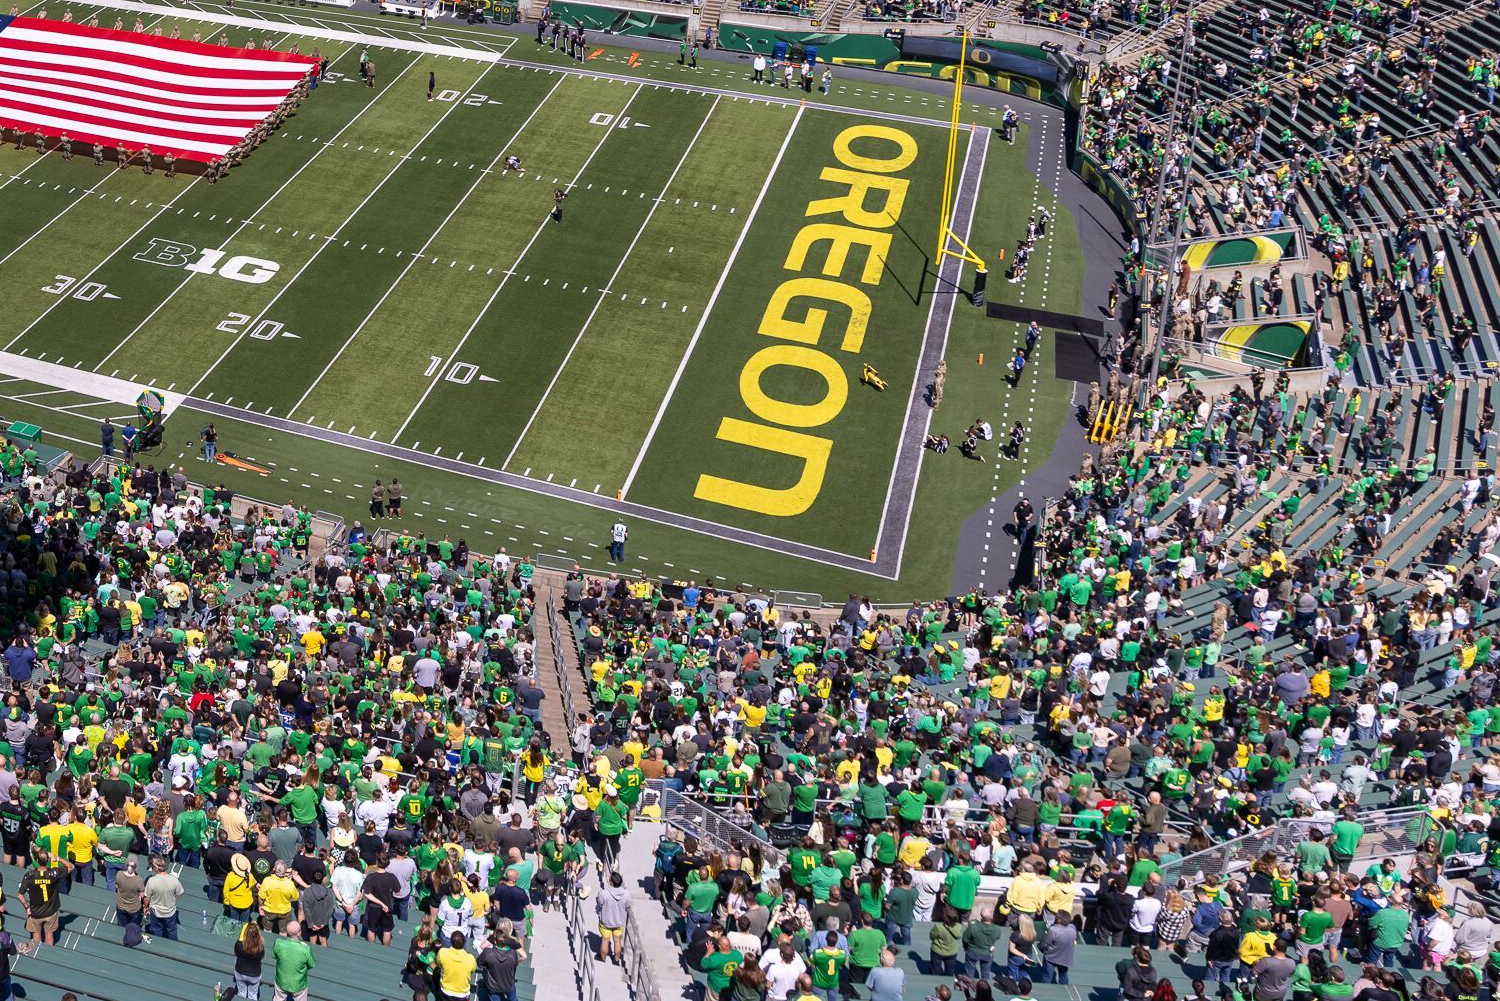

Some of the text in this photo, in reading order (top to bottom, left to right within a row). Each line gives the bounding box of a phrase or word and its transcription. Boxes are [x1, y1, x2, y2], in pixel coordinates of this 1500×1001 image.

[436, 89, 488, 107] 20
[589, 112, 632, 129] 10
[41, 275, 107, 302] 30
[216, 311, 285, 340] 20
[693, 124, 919, 517] OREGON
[423, 355, 481, 386] 10
[500, 691, 507, 703] 6
[57, 709, 63, 722] 1
[264, 779, 281, 791] 57
[627, 774, 640, 787] 21
[1178, 774, 1186, 785] 5
[557, 784, 568, 793] 20
[1412, 788, 1419, 801] 8
[408, 803, 421, 815] 10
[3, 817, 20, 833] 28
[802, 856, 816, 870] 14
[40, 884, 49, 902] 1
[1282, 886, 1289, 901] 1
[828, 958, 836, 976] 1
